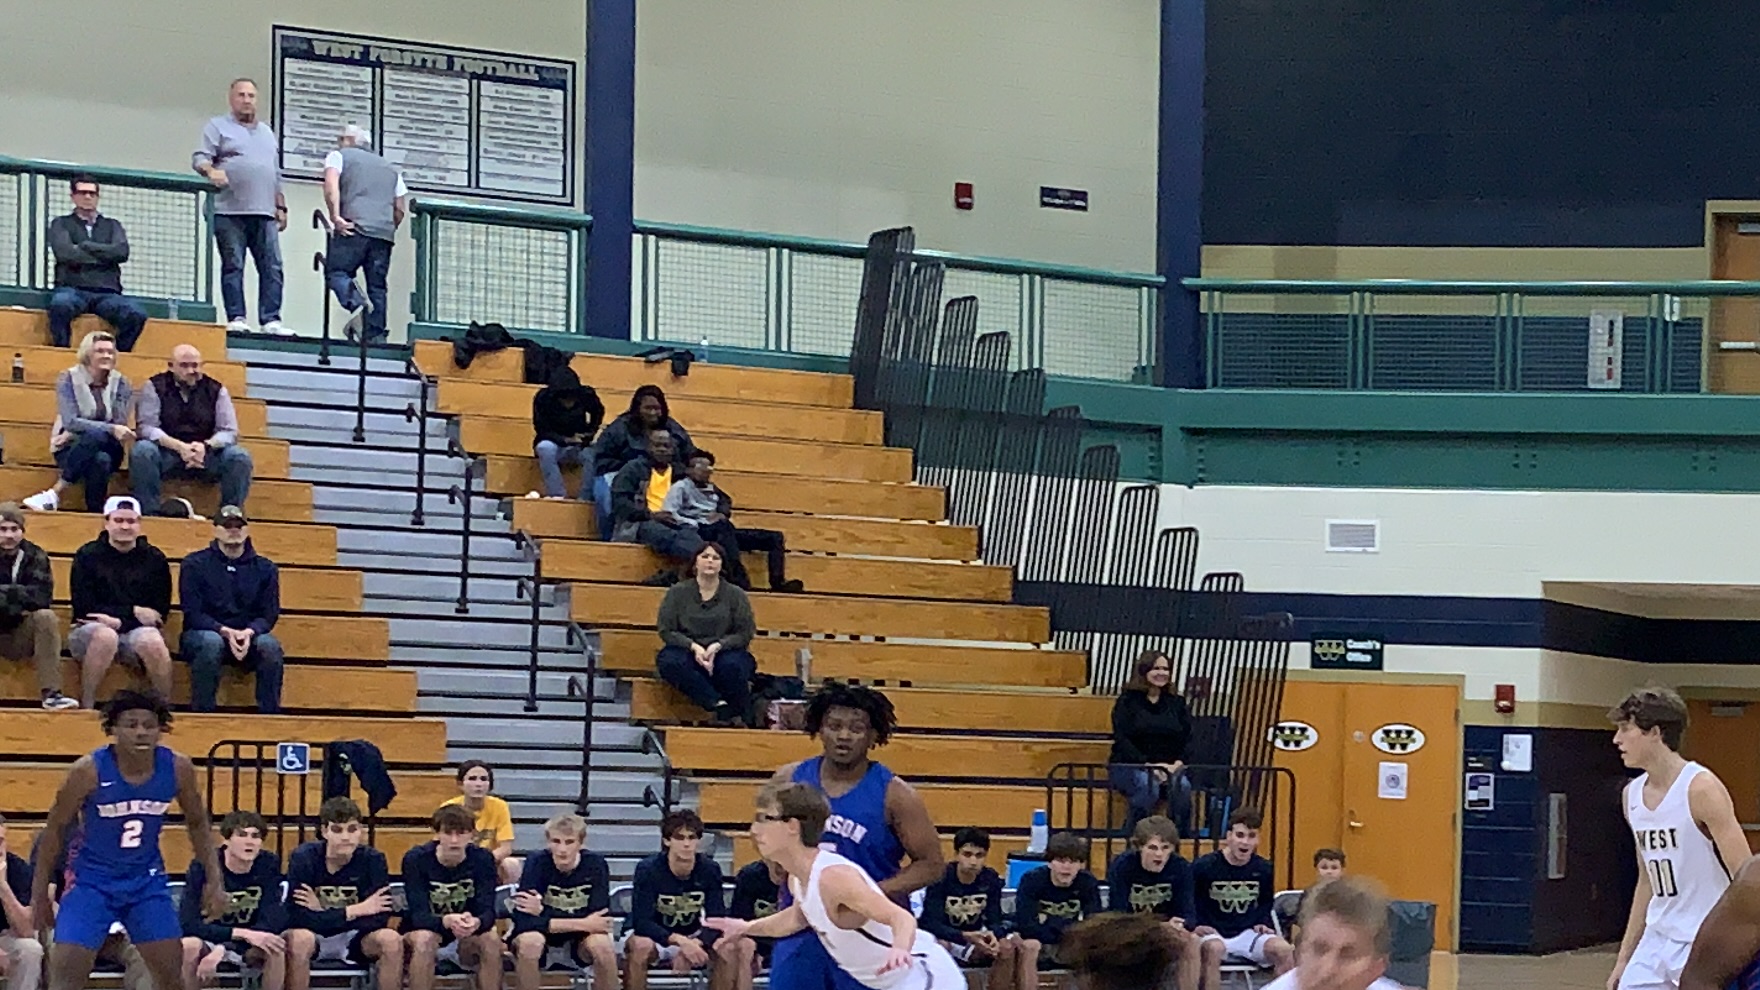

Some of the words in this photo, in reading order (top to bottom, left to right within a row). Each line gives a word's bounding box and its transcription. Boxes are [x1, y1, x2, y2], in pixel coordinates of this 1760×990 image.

[312, 40, 365, 59] WEST
[453, 57, 540, 81] FOOTBALL
[120, 819, 144, 849] 2
[1636, 827, 1678, 851] WEST
